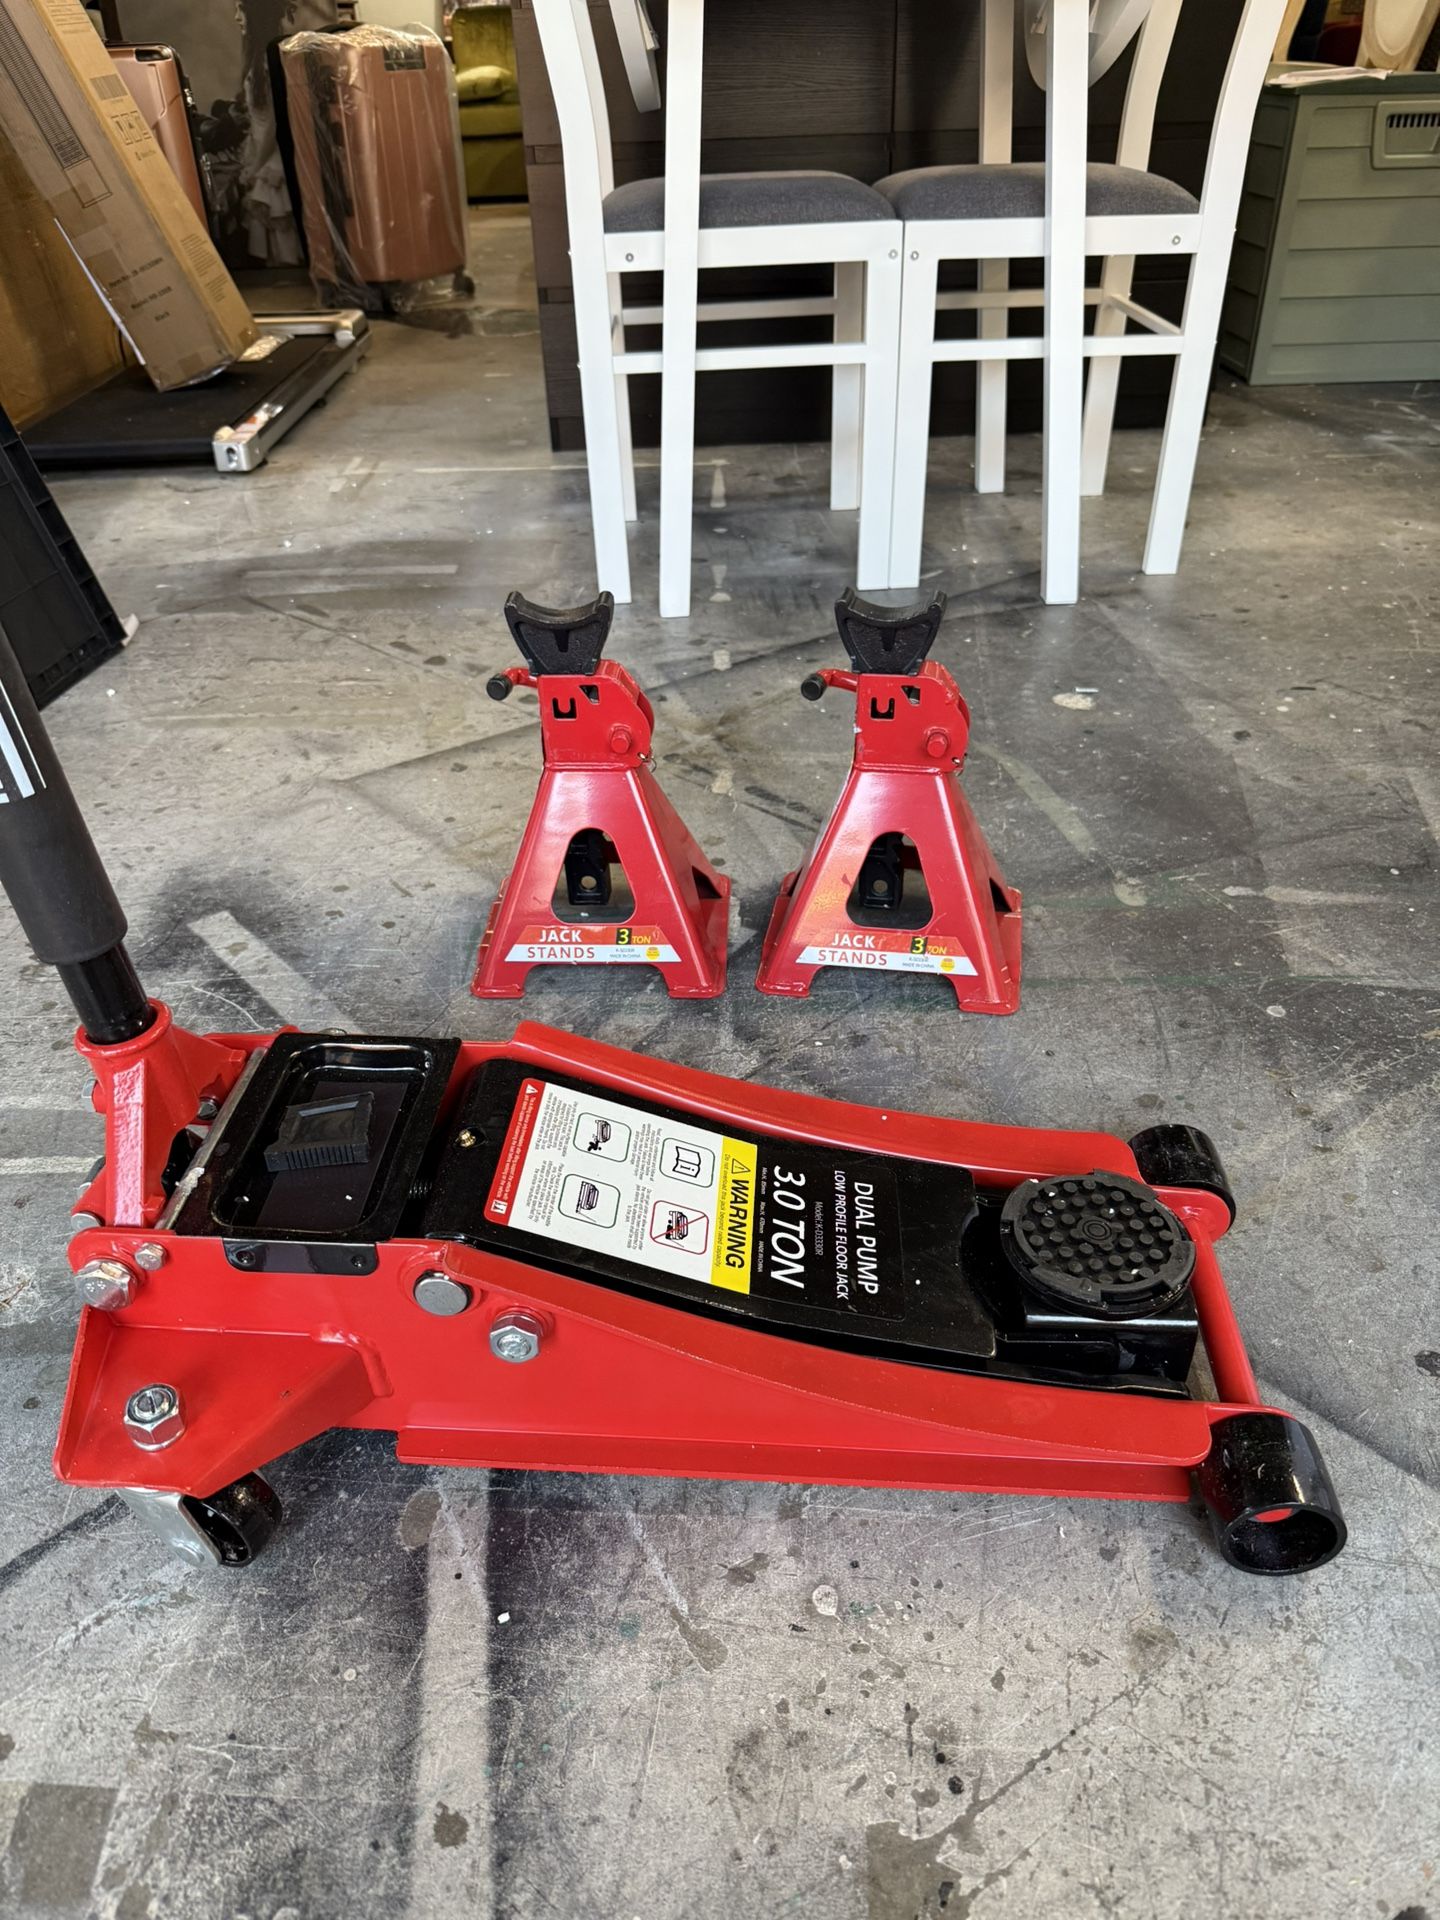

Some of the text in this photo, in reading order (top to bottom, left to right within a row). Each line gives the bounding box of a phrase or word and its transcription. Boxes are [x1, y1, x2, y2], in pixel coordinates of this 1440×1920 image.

[538, 928, 651, 945] JACK 3 TON
[831, 933, 947, 955] JACK 3 TON
[527, 947, 595, 959] STANDS
[818, 949, 888, 966] STANDS
[723, 1153, 730, 1161] Do
[725, 1178, 749, 1269] WARNING
[770, 1165, 806, 1289] 3.0 TON
[834, 1170, 849, 1300] LOW PROFILE FLOOR JACK
[854, 1182, 879, 1294] DUAL PUMP
